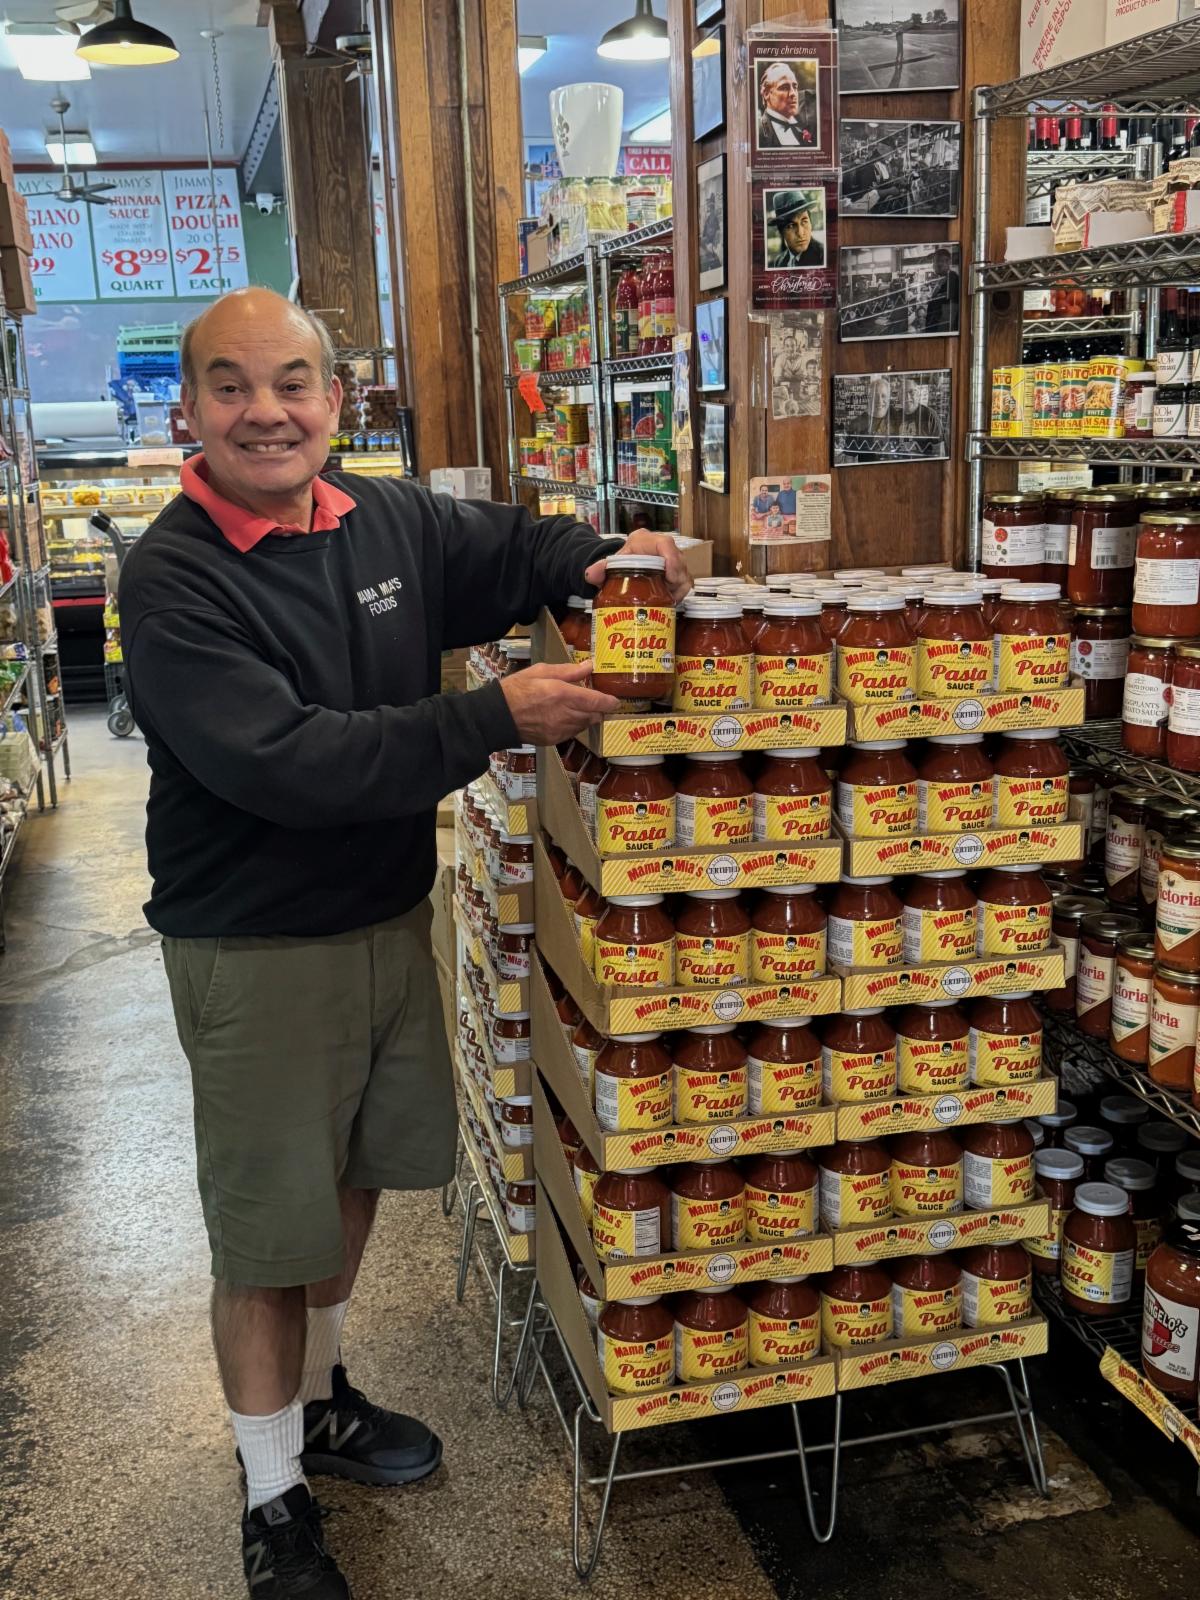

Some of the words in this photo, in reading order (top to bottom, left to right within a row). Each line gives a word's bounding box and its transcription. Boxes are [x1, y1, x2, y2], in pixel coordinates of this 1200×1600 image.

[1115, 1, 1140, 17] PRODUCT
[756, 47, 779, 57] merry
[780, 45, 817, 55] christmas
[1032, 21, 1054, 66] TENERE
[1042, 35, 1056, 61] NON
[630, 157, 670, 170] CALL
[175, 194, 232, 209] PIZZA
[109, 208, 150, 219] SAUCE
[172, 214, 239, 230] DOUGH
[111, 280, 164, 292] QUART
[190, 277, 232, 289] EACH
[369, 596, 397, 616] FOODS
[604, 610, 634, 628] Mama
[649, 609, 671, 628] Mia's
[608, 633, 667, 649] Pasta
[1011, 638, 1043, 655] Mama
[845, 650, 874, 666] Mama
[890, 650, 911, 664] Mia's
[927, 644, 958, 659] Mama
[971, 644, 991, 659] Mia's
[676, 659, 701, 675] Mama
[717, 659, 742, 675] Mia's
[756, 660, 783, 674] Mama
[798, 658, 823, 674] Mia's
[930, 664, 987, 681] Pasta
[1015, 660, 1069, 675] Pasta
[760, 680, 818, 696] Pasta
[849, 673, 907, 689] Pasta
[947, 682, 974, 690] SAUCE
[1033, 676, 1059, 684] SAUCE
[680, 681, 737, 697] Pasta
[986, 698, 1018, 718] Mama
[1031, 695, 1060, 712] Mia's
[876, 706, 908, 727] Mama
[921, 704, 949, 721] Mia's
[628, 722, 662, 742] Mama
[676, 720, 706, 738] Mia's
[745, 717, 778, 737] Mama
[792, 714, 821, 732] Mia's
[605, 805, 634, 820] Mama
[649, 803, 670, 816] Mia's
[1013, 801, 1065, 816] Pasta
[609, 825, 667, 841] Pasta
[1107, 832, 1140, 848] ctoria
[877, 842, 909, 862] Mama
[922, 839, 949, 855] Mia's
[986, 834, 1017, 854] Mama
[1030, 831, 1057, 847] Mia's
[505, 863, 526, 879] Mia's
[627, 863, 660, 882] Mama
[674, 860, 703, 877] Mia's
[741, 855, 774, 874] Mama
[788, 853, 815, 870] Mia's
[1159, 883, 1200, 906] ictoria
[757, 937, 783, 949] Mama
[797, 936, 820, 949] Mia's
[999, 928, 1050, 942] Pasta
[677, 939, 700, 952] Mama
[715, 939, 740, 954] Mia's
[1017, 943, 1041, 951] SAUCE
[507, 954, 529, 969] Mia's
[680, 957, 735, 975] Pasta
[760, 955, 815, 971] Pasta
[693, 976, 720, 984] SAUCE
[974, 964, 1004, 984] Mama
[1017, 962, 1043, 978] Mia's
[867, 976, 897, 996] Mama
[911, 973, 938, 988] Mia's
[746, 989, 777, 1008] Mama
[791, 986, 818, 1002] Mia's
[1115, 984, 1149, 1003] ctoria
[635, 999, 667, 1019] Mama
[680, 997, 709, 1012] Mia's
[861, 1106, 890, 1126] Mama
[903, 1102, 930, 1117] Mia's
[631, 1136, 662, 1156] Mama
[676, 1133, 703, 1148] Mia's
[898, 1169, 925, 1179] Mama
[940, 1168, 960, 1180] Mia's
[780, 1193, 805, 1208] Mia's
[902, 1186, 955, 1202] Pasta
[747, 1208, 800, 1228] Pasta
[759, 1228, 784, 1237] SAUCE
[856, 1232, 885, 1251] Mama
[898, 1228, 924, 1242] Mia's
[739, 1251, 769, 1270] Mama
[782, 1247, 809, 1263] Mia's
[1077, 1248, 1102, 1267] Mia's
[631, 1265, 662, 1286] Mama
[676, 1261, 703, 1276] Mia's
[830, 1304, 858, 1316] Mama
[835, 1322, 887, 1337] Pasta
[851, 1337, 875, 1345] SAUCE
[961, 1336, 989, 1357] Mama
[1001, 1333, 1025, 1346] Mia's
[859, 1355, 889, 1375] Mama
[902, 1351, 927, 1364] Mia's
[744, 1378, 774, 1398] Mama
[786, 1372, 812, 1387] Mia's
[637, 1396, 668, 1416] Mama
[681, 1391, 708, 1406] Mia's
